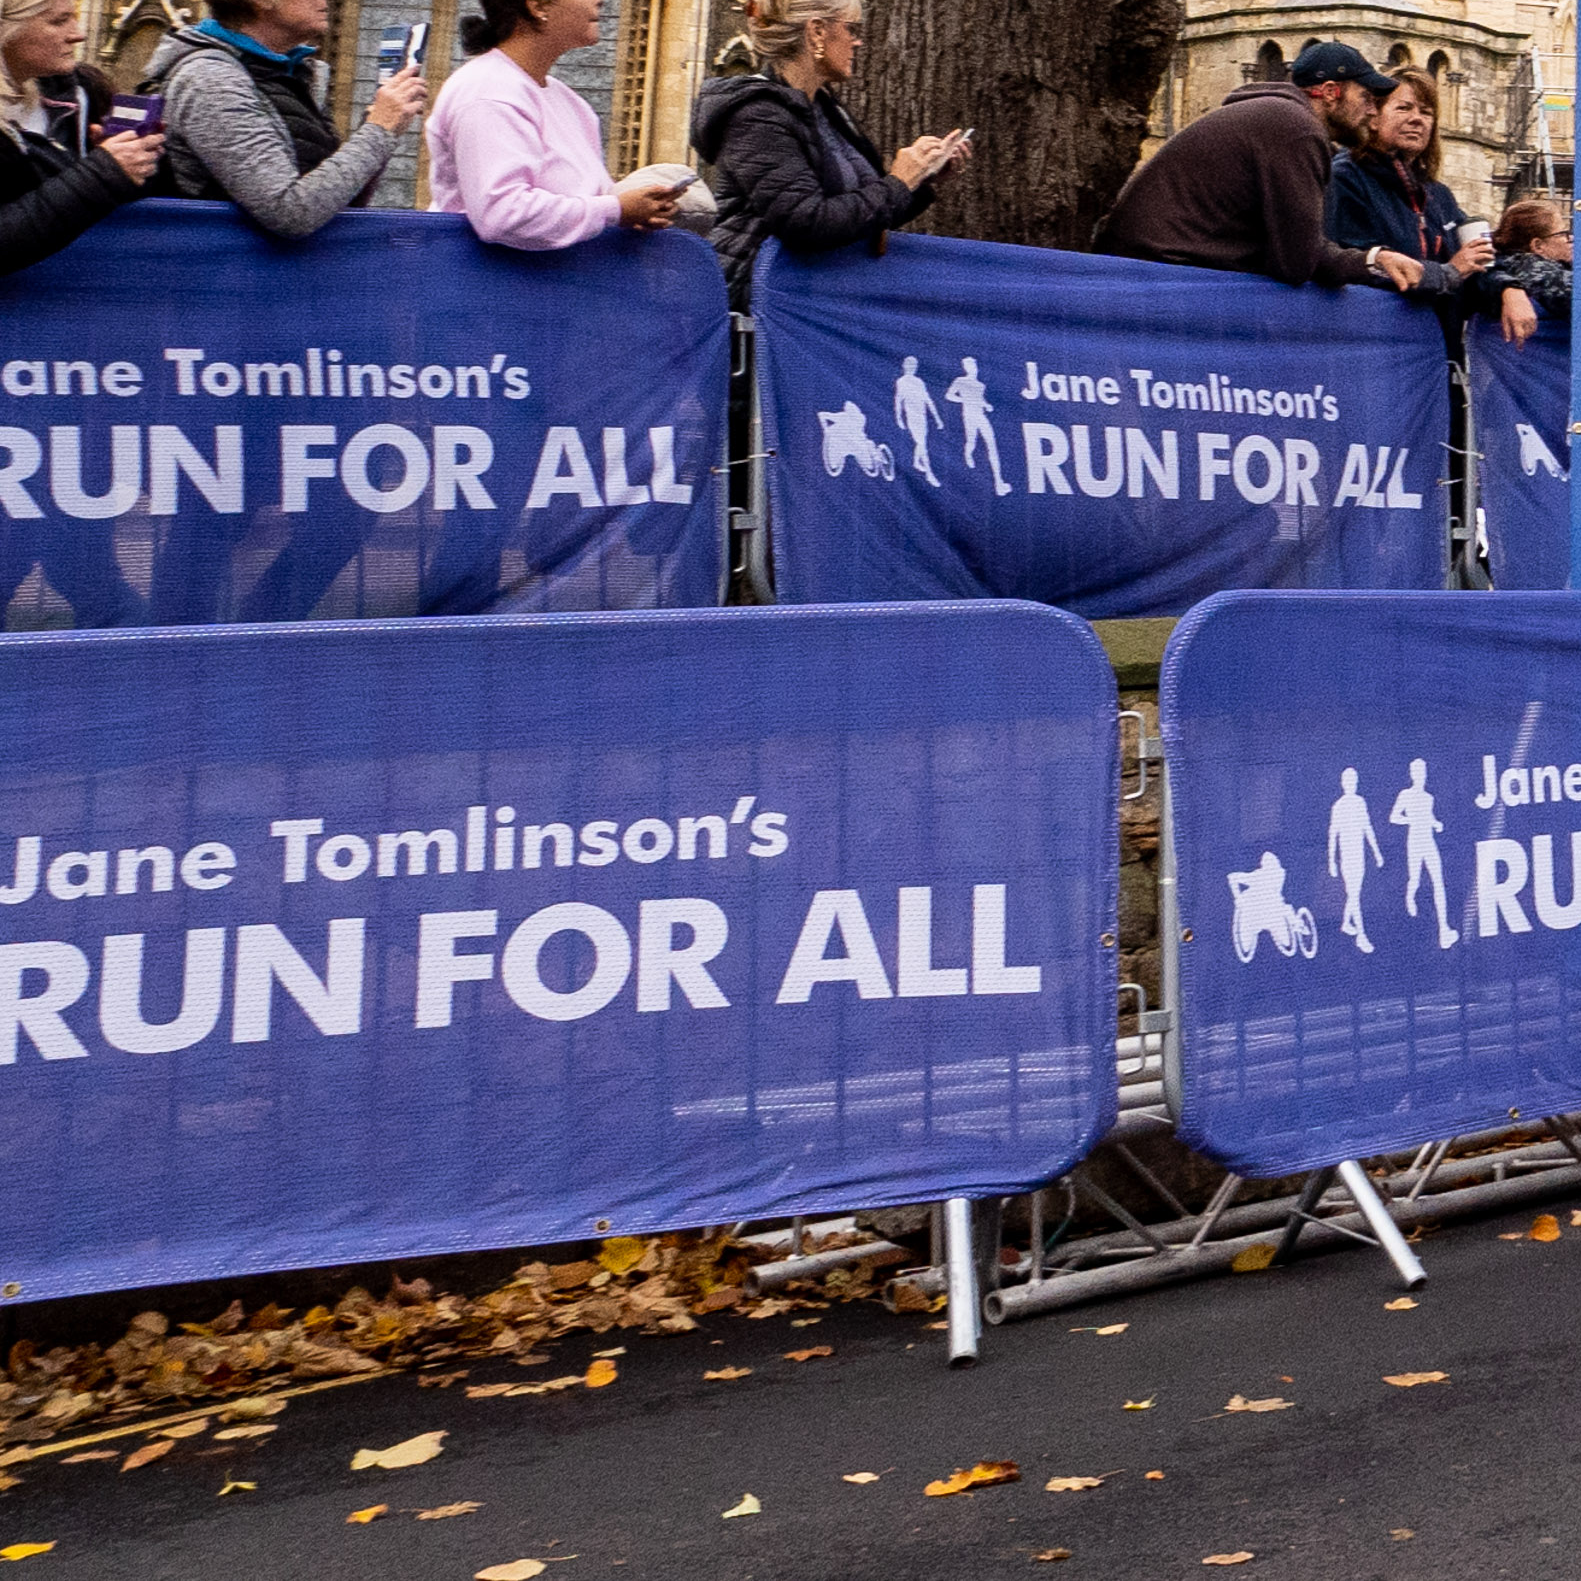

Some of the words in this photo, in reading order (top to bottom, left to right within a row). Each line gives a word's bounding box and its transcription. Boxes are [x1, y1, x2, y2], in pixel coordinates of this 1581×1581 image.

[0, 357, 144, 397] ane
[164, 348, 530, 399] Tomlinson's
[1021, 362, 1120, 405] Jane
[1129, 368, 1339, 421] Tomlinson's
[0, 424, 243, 518] RUN
[281, 423, 497, 513] FOR
[525, 424, 692, 508] ALL
[1023, 423, 1178, 500] RUN
[1199, 431, 1320, 506] FOR
[1334, 444, 1423, 511] ALL
[0, 838, 237, 903] Jane
[270, 796, 788, 884] Tomlinson's
[0, 918, 365, 1065] RUN
[413, 897, 731, 1028] FOR
[775, 883, 1041, 1003] ALL
